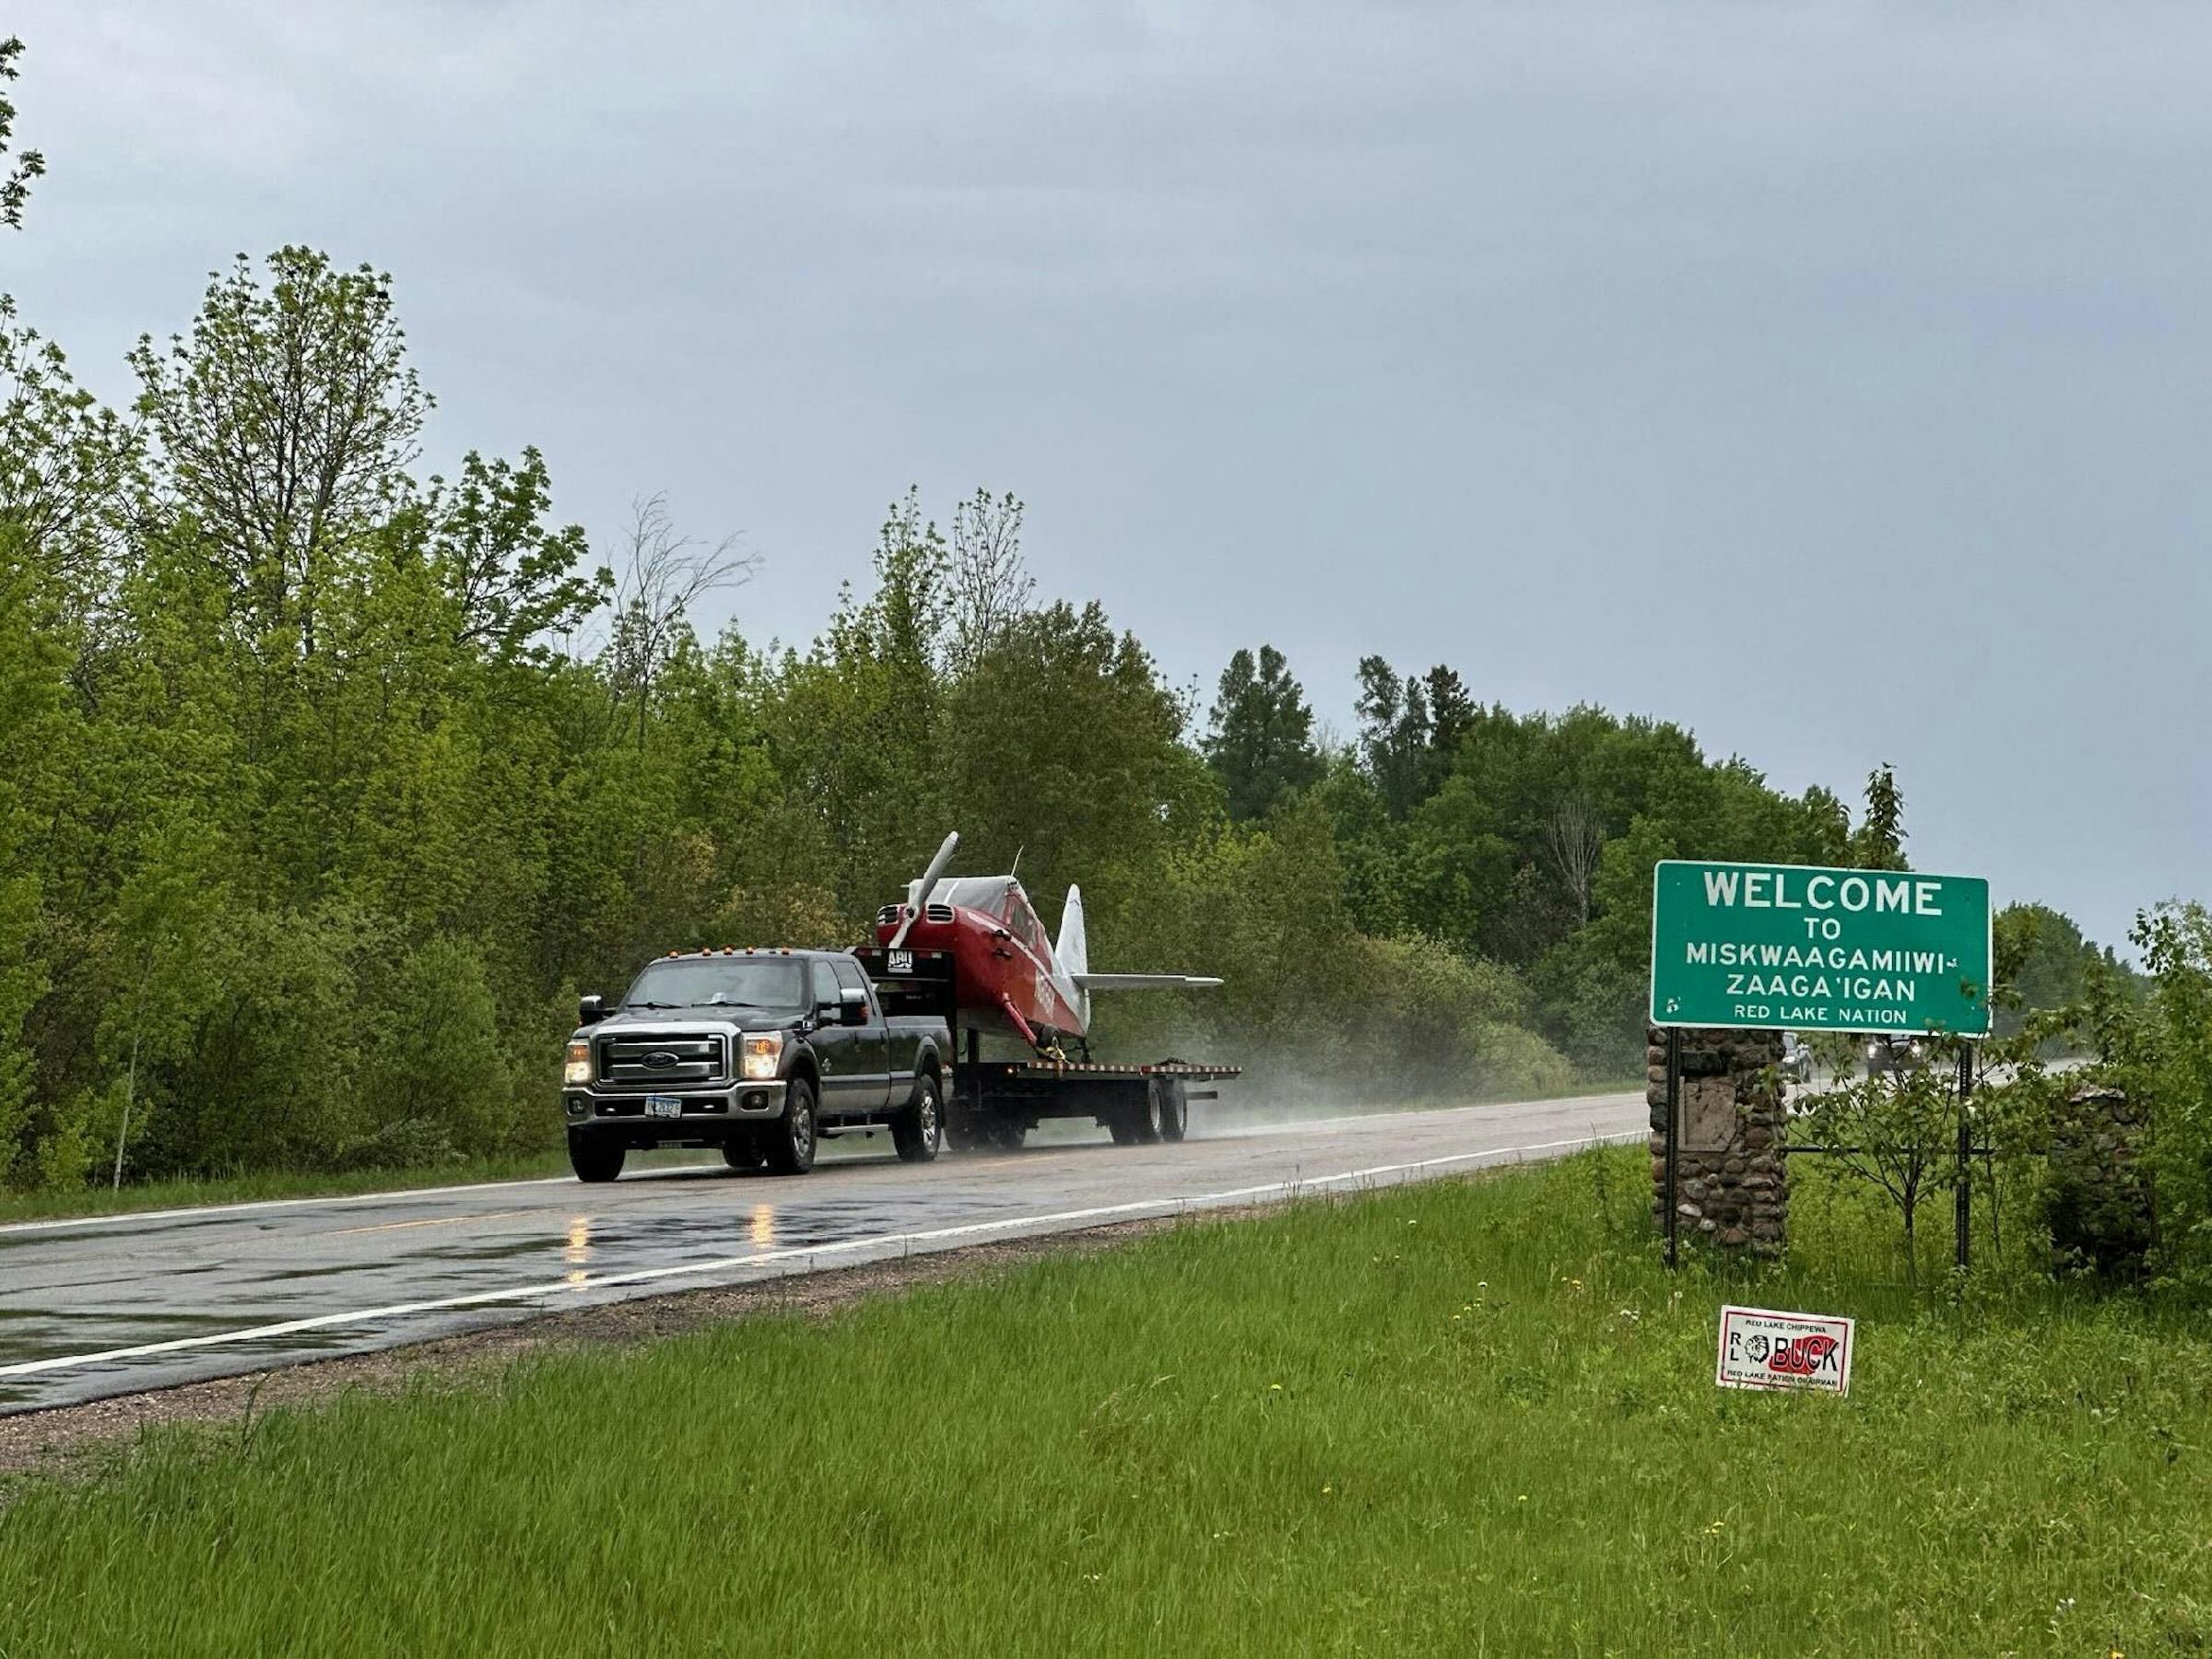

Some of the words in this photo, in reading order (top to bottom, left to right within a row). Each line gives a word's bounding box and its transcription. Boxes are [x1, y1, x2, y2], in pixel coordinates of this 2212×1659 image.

[1703, 871, 1943, 916] WELCOME
[1804, 917, 1841, 940] TO
[1735, 1005, 1771, 1019] RED
[1780, 1006, 1829, 1021] LAKE
[1839, 1008, 1907, 1025] NATION
[1786, 1324, 1827, 1334] CHIPPEWA
[1773, 1337, 1840, 1371] BUCK
[1745, 1371, 1766, 1380] LAKE
